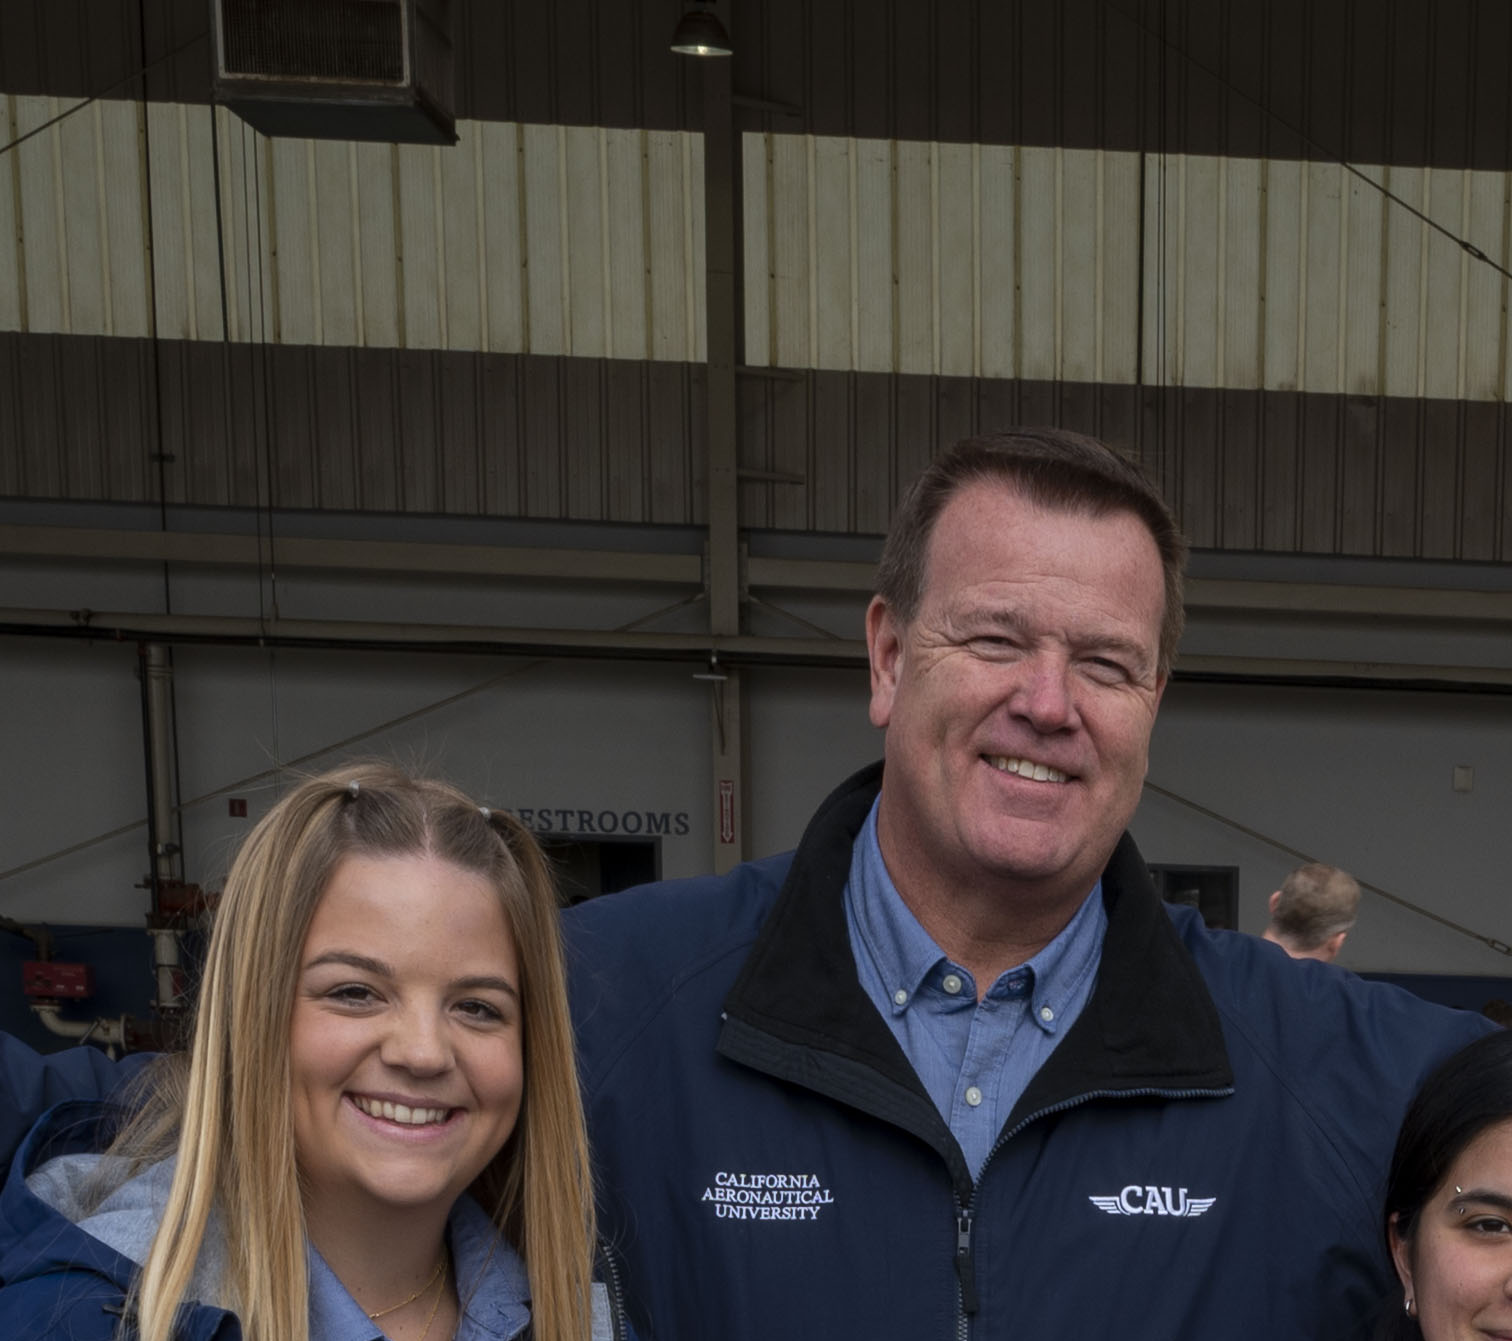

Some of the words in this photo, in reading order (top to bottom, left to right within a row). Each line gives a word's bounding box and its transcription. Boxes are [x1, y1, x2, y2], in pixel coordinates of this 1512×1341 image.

[508, 808, 691, 836] ESTROOMS
[714, 1171, 821, 1189] CALIFORNIA
[701, 1187, 835, 1205] AERONAUTICAL
[1119, 1185, 1188, 1217] CAU
[714, 1203, 821, 1221] UNIVERSITY
